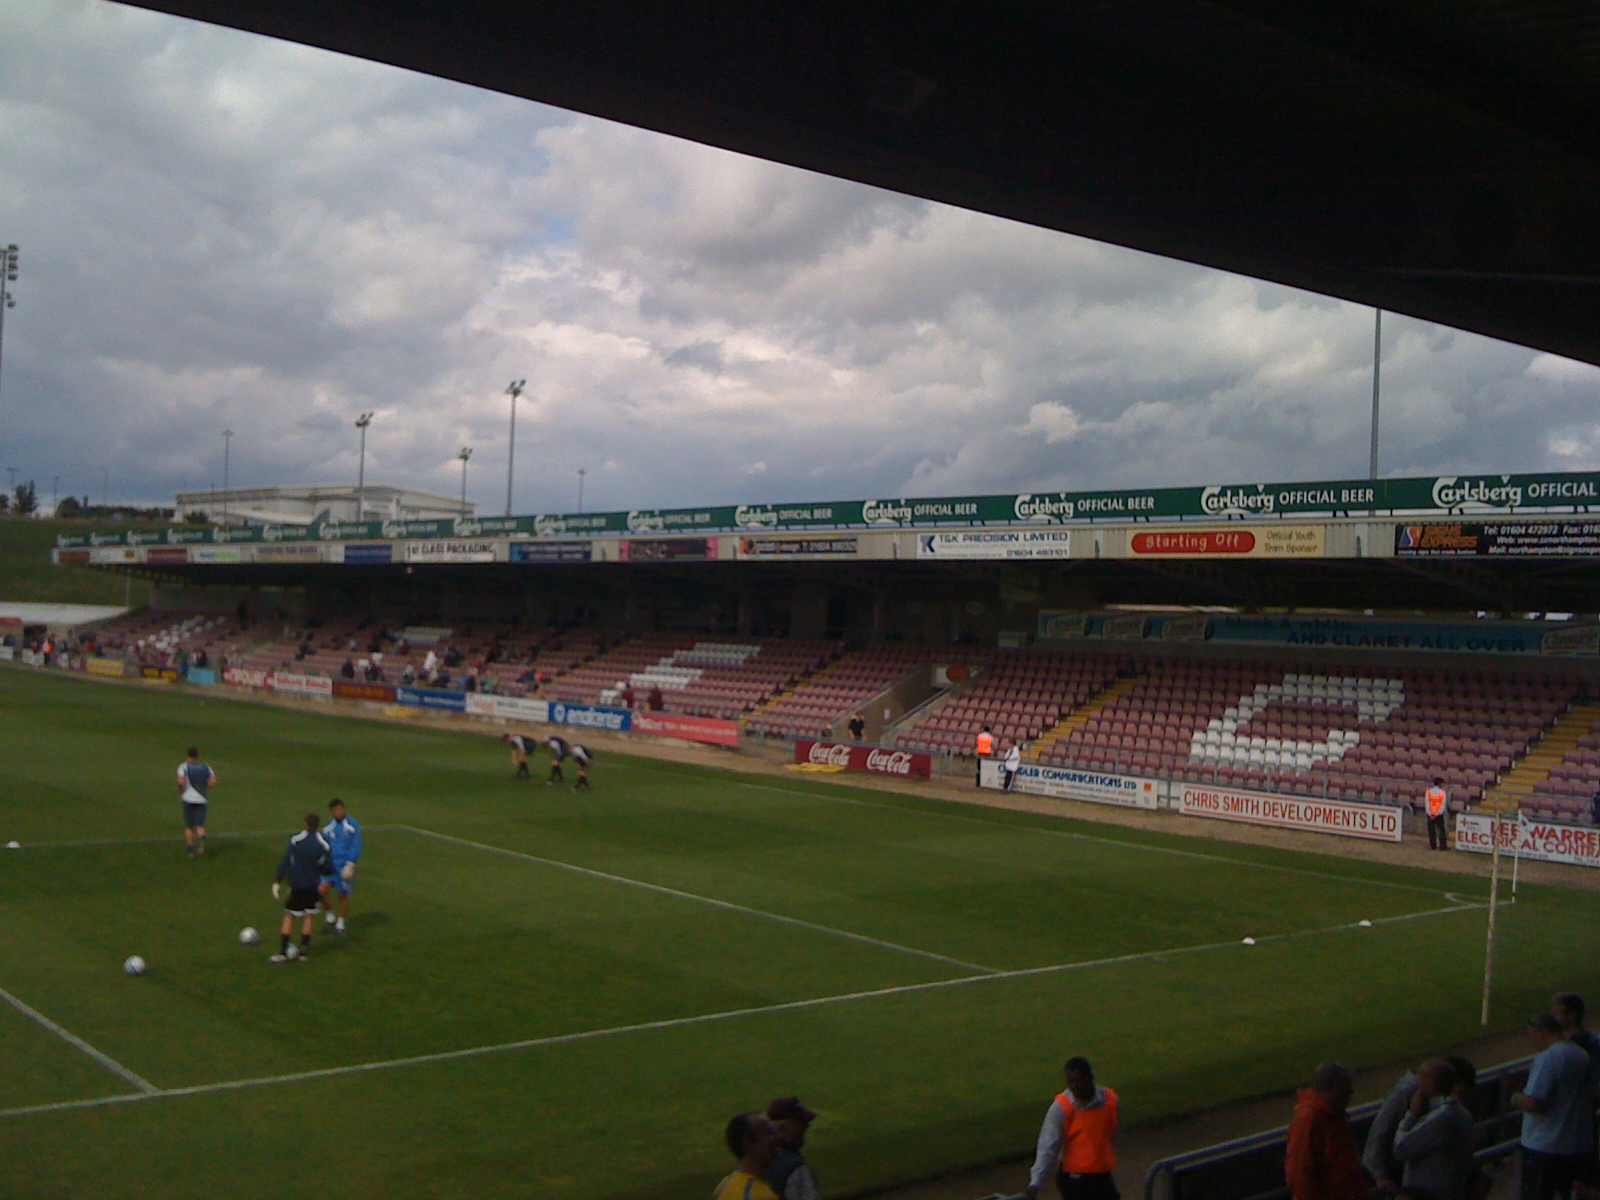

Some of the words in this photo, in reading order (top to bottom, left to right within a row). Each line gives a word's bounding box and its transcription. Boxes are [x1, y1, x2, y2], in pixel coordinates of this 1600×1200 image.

[1200, 485, 1274, 515] Carlsberg
[1279, 490, 1336, 505] OFFICIAL
[1341, 488, 1374, 502] BEER
[1432, 476, 1522, 508] Carlsberg
[1528, 482, 1597, 497] OFFICIAL
[735, 504, 778, 527] Carlsberg
[862, 500, 913, 523] Carlsberg
[914, 504, 953, 516] OFFICIAL
[955, 503, 978, 515] BEER
[1014, 493, 1074, 519] Carlsberg
[1077, 499, 1124, 512] OFFICIAL
[1127, 496, 1155, 510] BEER
[963, 533, 1020, 543] PRECISION
[1023, 532, 1068, 541] LIMITED
[1267, 530, 1293, 540] Official
[1295, 531, 1316, 540] Youth
[1500, 526, 1526, 535] 01604
[1146, 535, 1207, 552] Starting
[1215, 533, 1240, 548] Off
[1286, 543, 1319, 553] Sponsor
[1286, 632, 1328, 645] AND
[1332, 633, 1415, 649] CLARET
[1420, 636, 1461, 650] ALL
[1465, 637, 1527, 652] OVER
[1042, 768, 1122, 788] COMMUNICATIONS
[1124, 781, 1137, 790] LTD
[1184, 790, 1220, 810] CHRIS
[1223, 796, 1260, 816] SMITH
[1263, 801, 1368, 830] DEVELOPMENTS
[1371, 813, 1396, 832] LTD
[1529, 825, 1600, 846] WARRE
